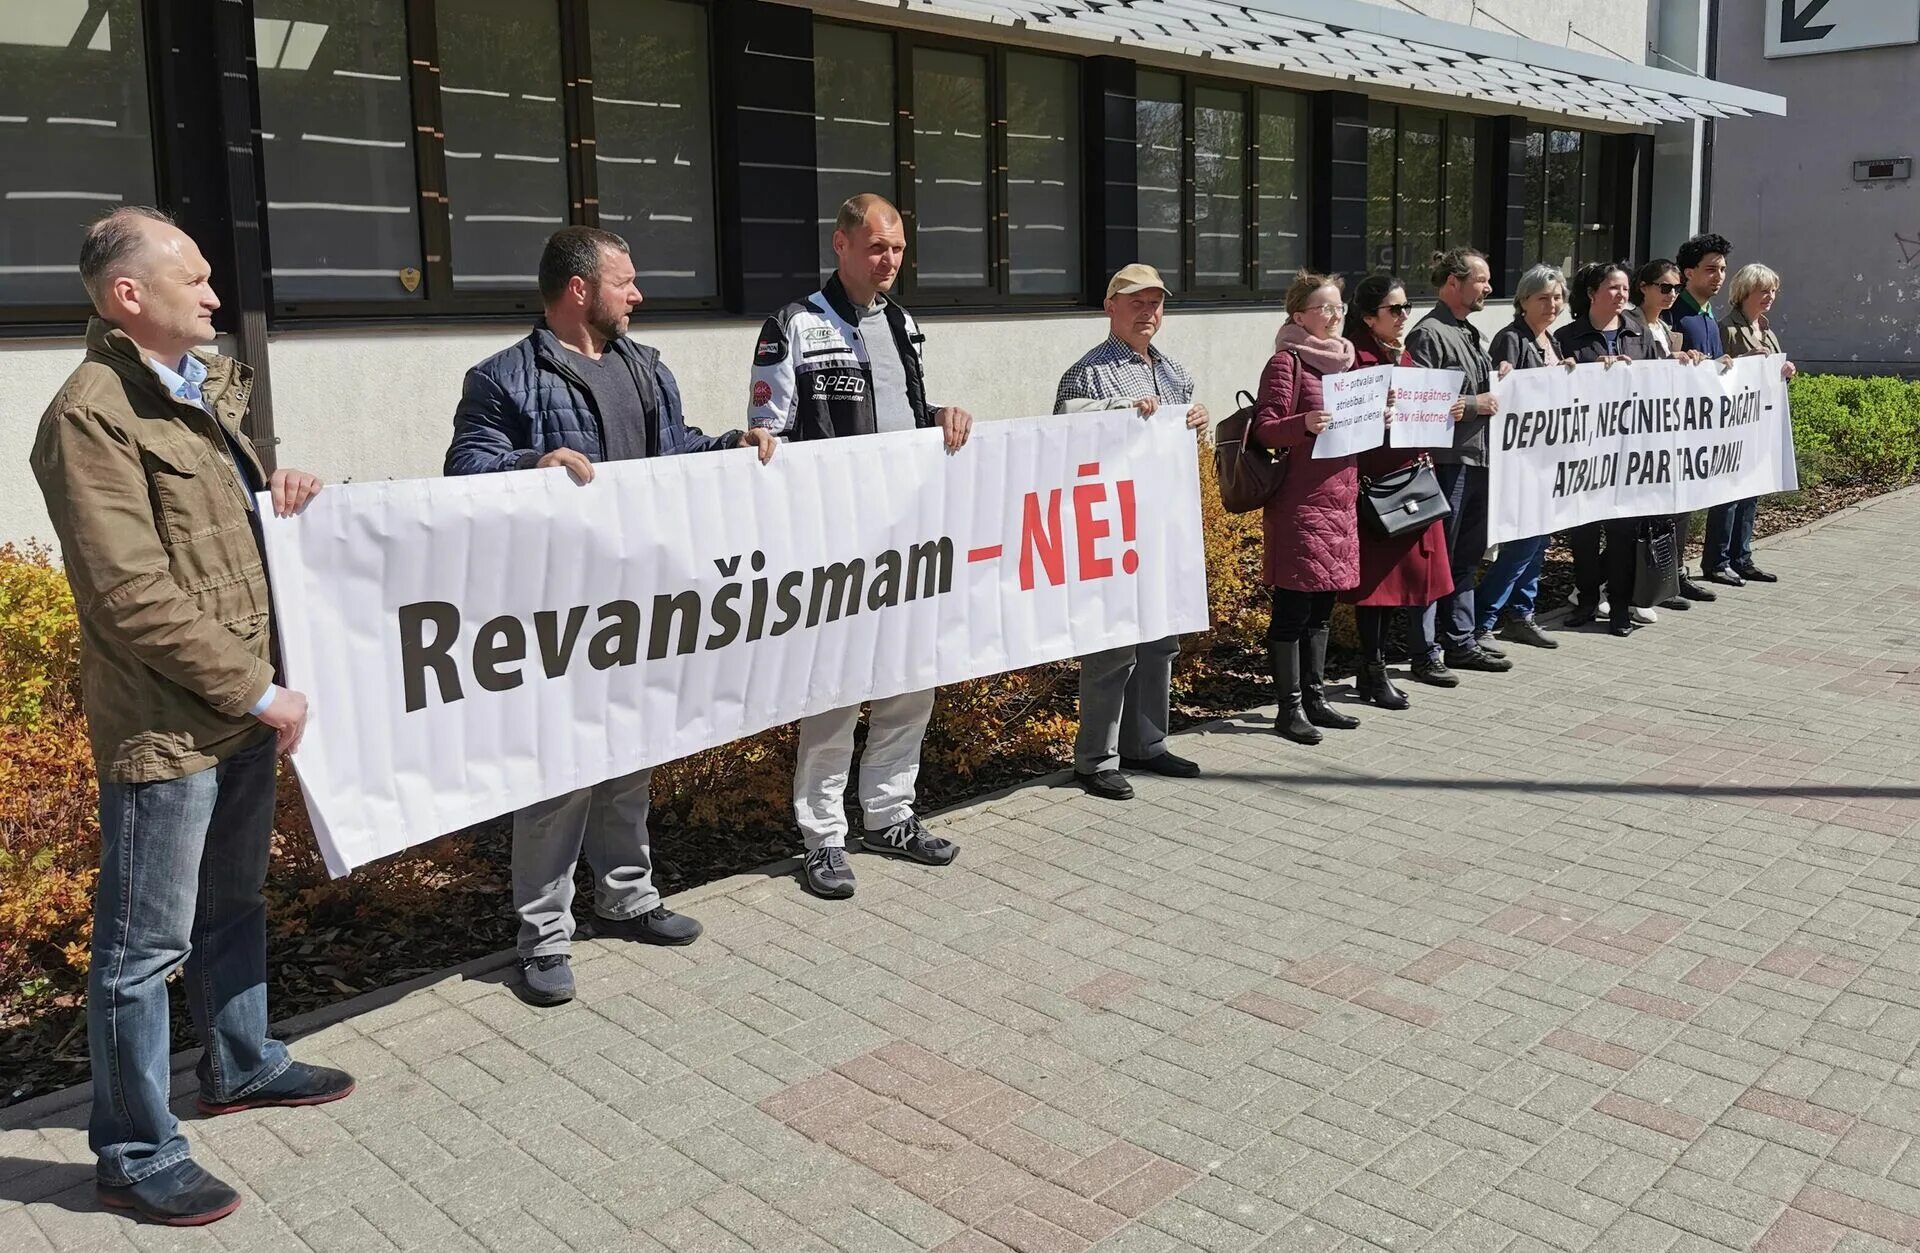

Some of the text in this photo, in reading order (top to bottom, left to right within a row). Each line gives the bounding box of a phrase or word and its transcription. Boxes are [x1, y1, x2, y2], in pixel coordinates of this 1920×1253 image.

[814, 374, 866, 393] SPEED
[1397, 388, 1452, 403] Bez pagātnes
[1502, 397, 1593, 451] DEPUTĀT,
[1552, 440, 1744, 499] ATBILDI PAR TAGADNI!
[398, 536, 954, 714] Revanšismam
[1019, 462, 1139, 591] NĒ!
